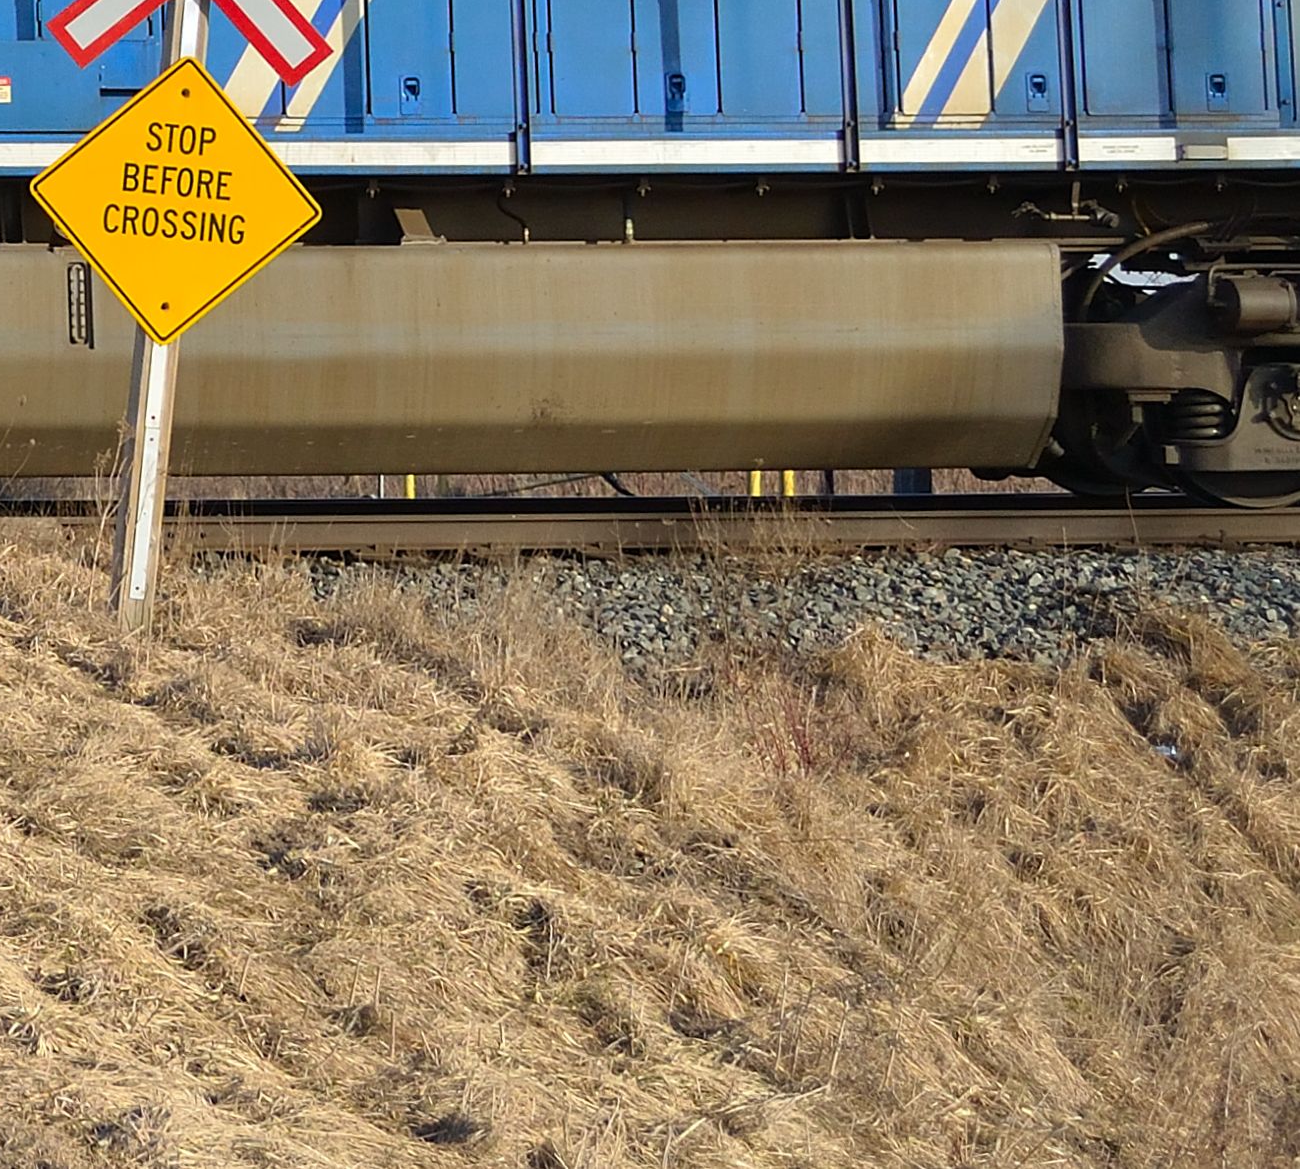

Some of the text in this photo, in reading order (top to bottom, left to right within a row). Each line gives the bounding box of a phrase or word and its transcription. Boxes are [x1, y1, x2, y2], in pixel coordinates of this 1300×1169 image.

[146, 122, 216, 156] STOP
[122, 162, 233, 201] BEFORE
[103, 203, 246, 245] CROSSING
